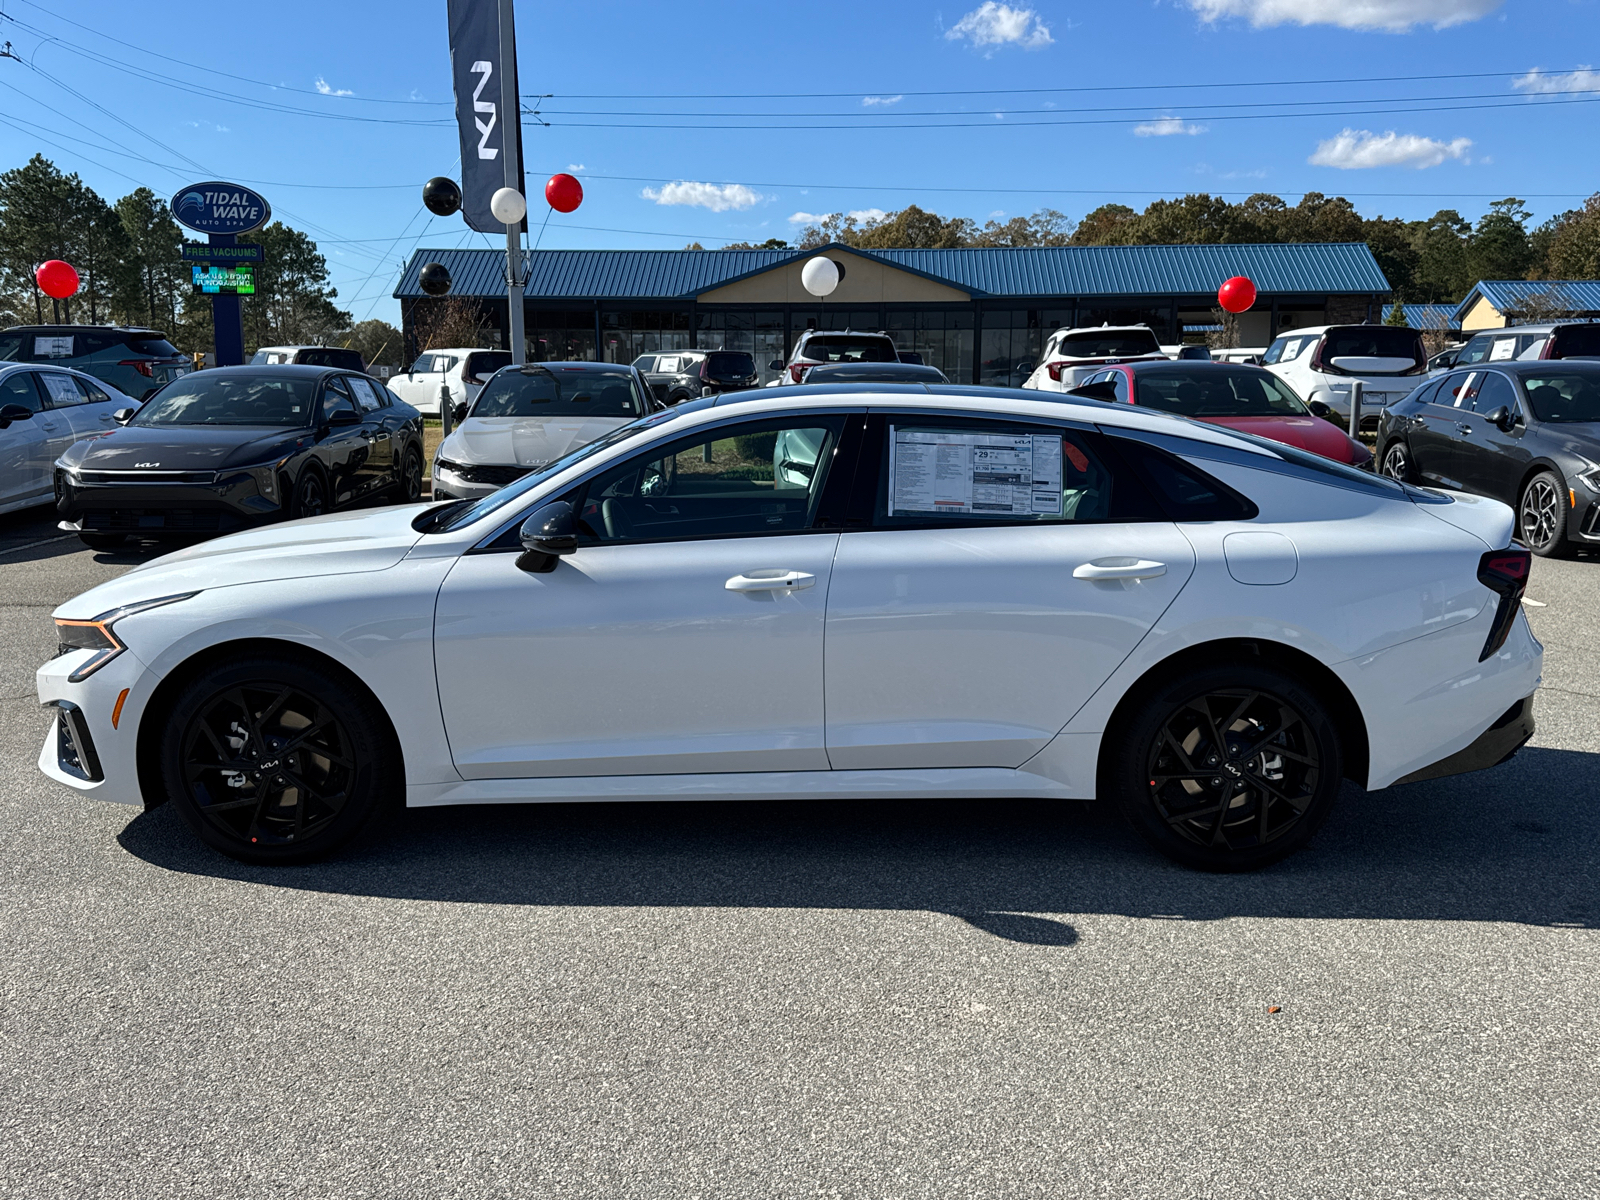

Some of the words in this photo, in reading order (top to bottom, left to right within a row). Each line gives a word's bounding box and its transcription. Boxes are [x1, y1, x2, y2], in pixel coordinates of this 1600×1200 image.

[205, 192, 249, 205] TIDAL
[213, 206, 258, 219] WAVE
[186, 247, 210, 256] FREE
[213, 248, 257, 257] VACUUMS
[260, 759, 279, 770] KIA
[1223, 763, 1242, 777] KIA
